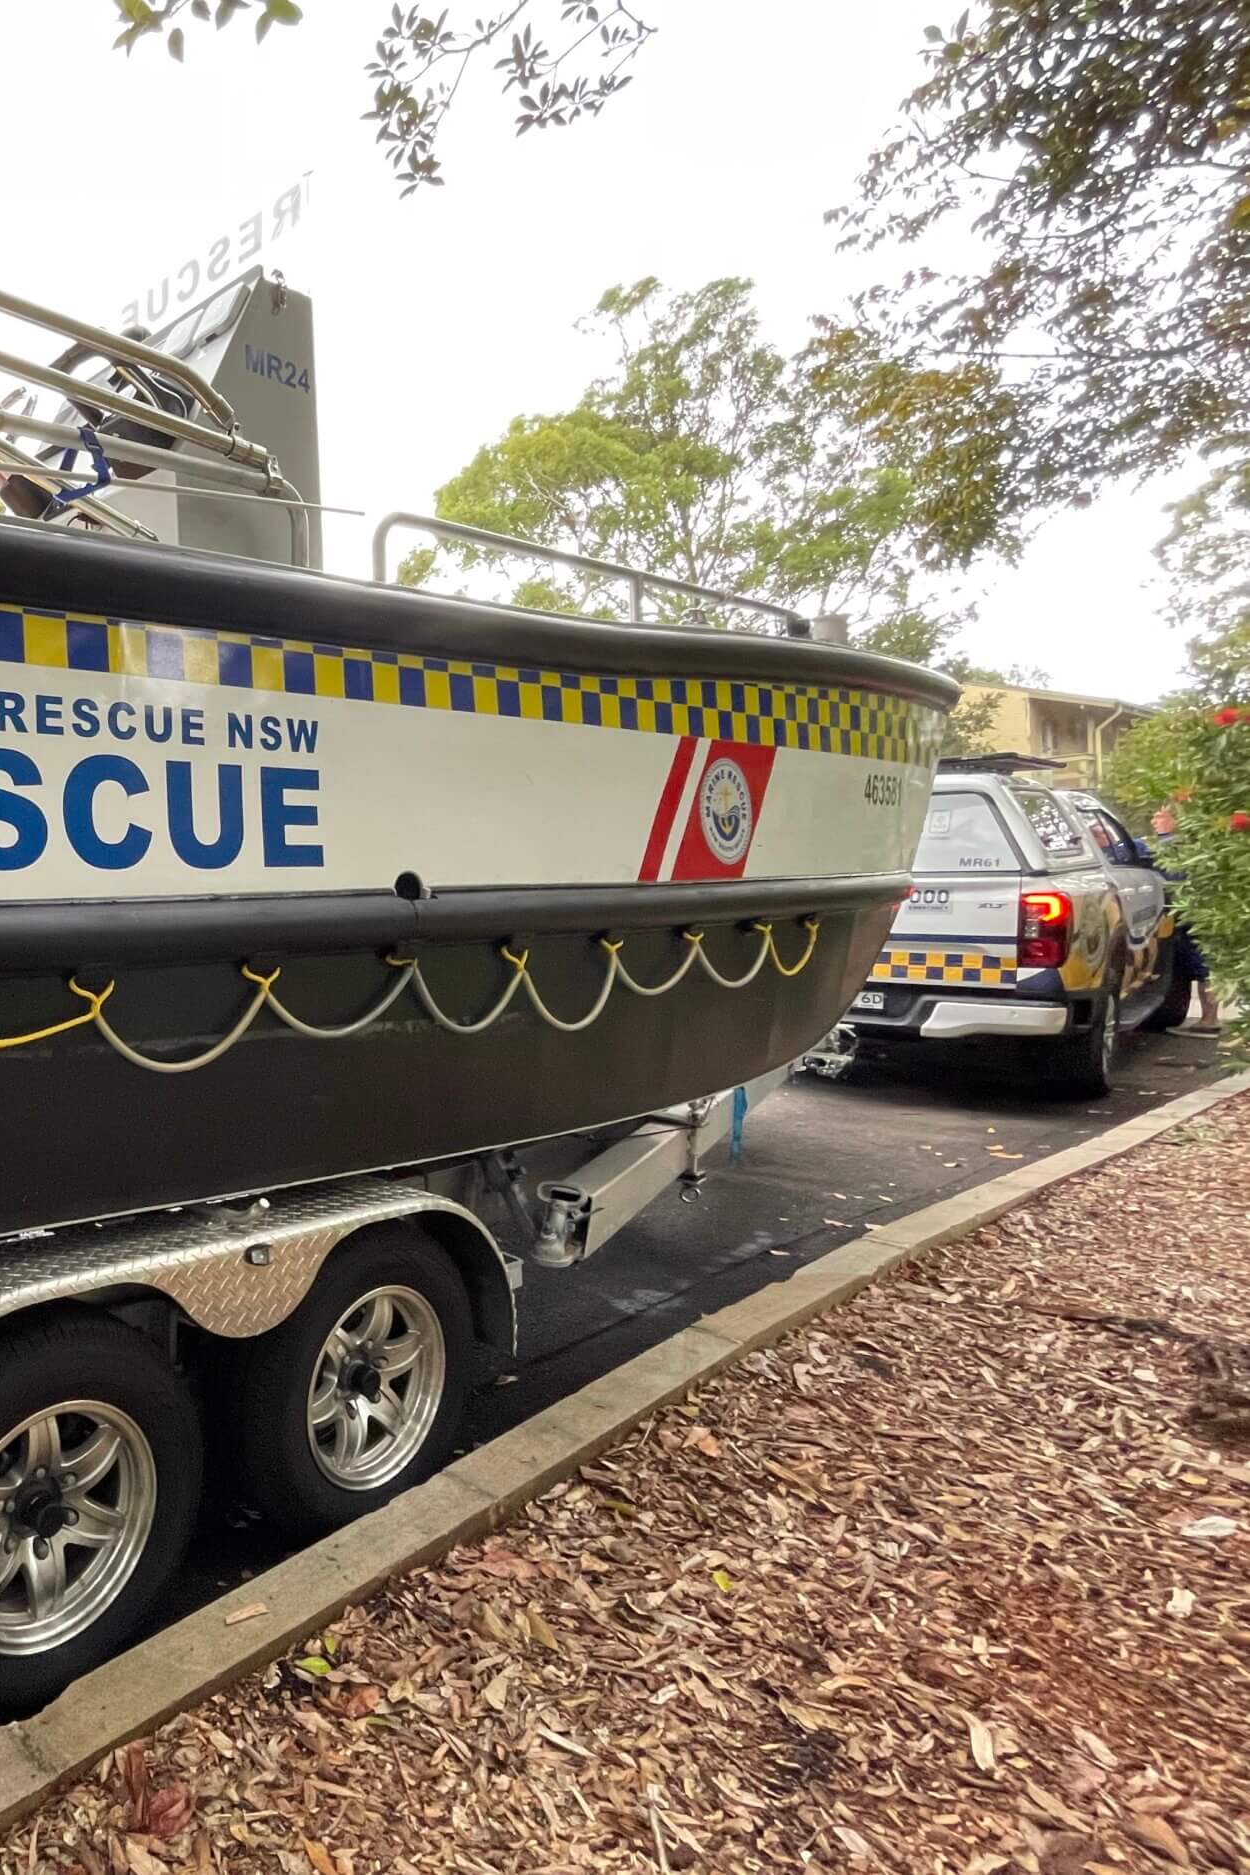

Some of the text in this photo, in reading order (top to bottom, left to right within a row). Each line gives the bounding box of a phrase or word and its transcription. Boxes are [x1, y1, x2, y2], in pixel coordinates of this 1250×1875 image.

[245, 344, 310, 393] MR24
[228, 713, 319, 753] NSW
[864, 774, 903, 807] 463581
[958, 857, 1001, 868] MR61
[910, 889, 950, 904] 000
